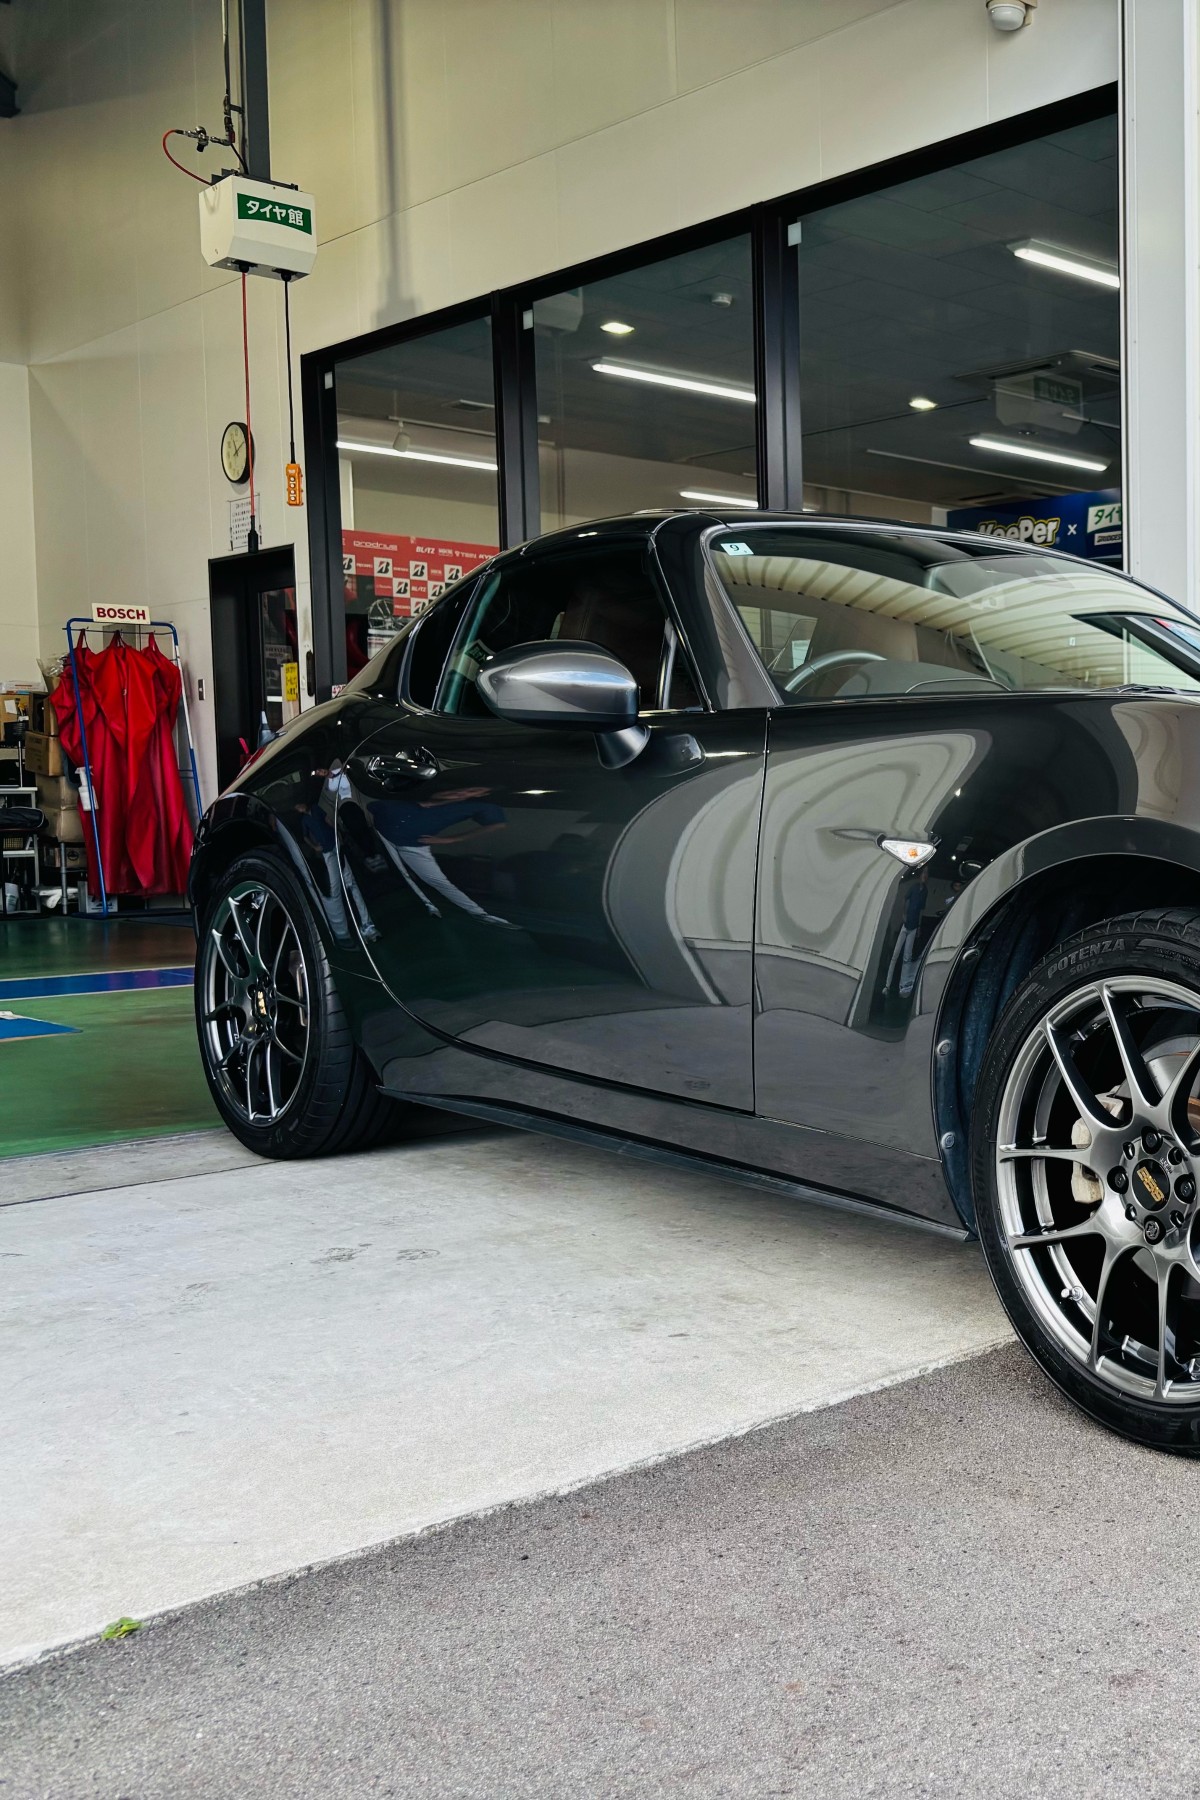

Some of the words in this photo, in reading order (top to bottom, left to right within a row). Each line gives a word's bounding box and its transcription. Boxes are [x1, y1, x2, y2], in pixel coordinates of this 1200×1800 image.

[246, 199, 304, 227] タイヤ館
[415, 546, 436, 555] BLITZ
[96, 606, 146, 621] BOSCH
[1047, 938, 1126, 978] POTENZA
